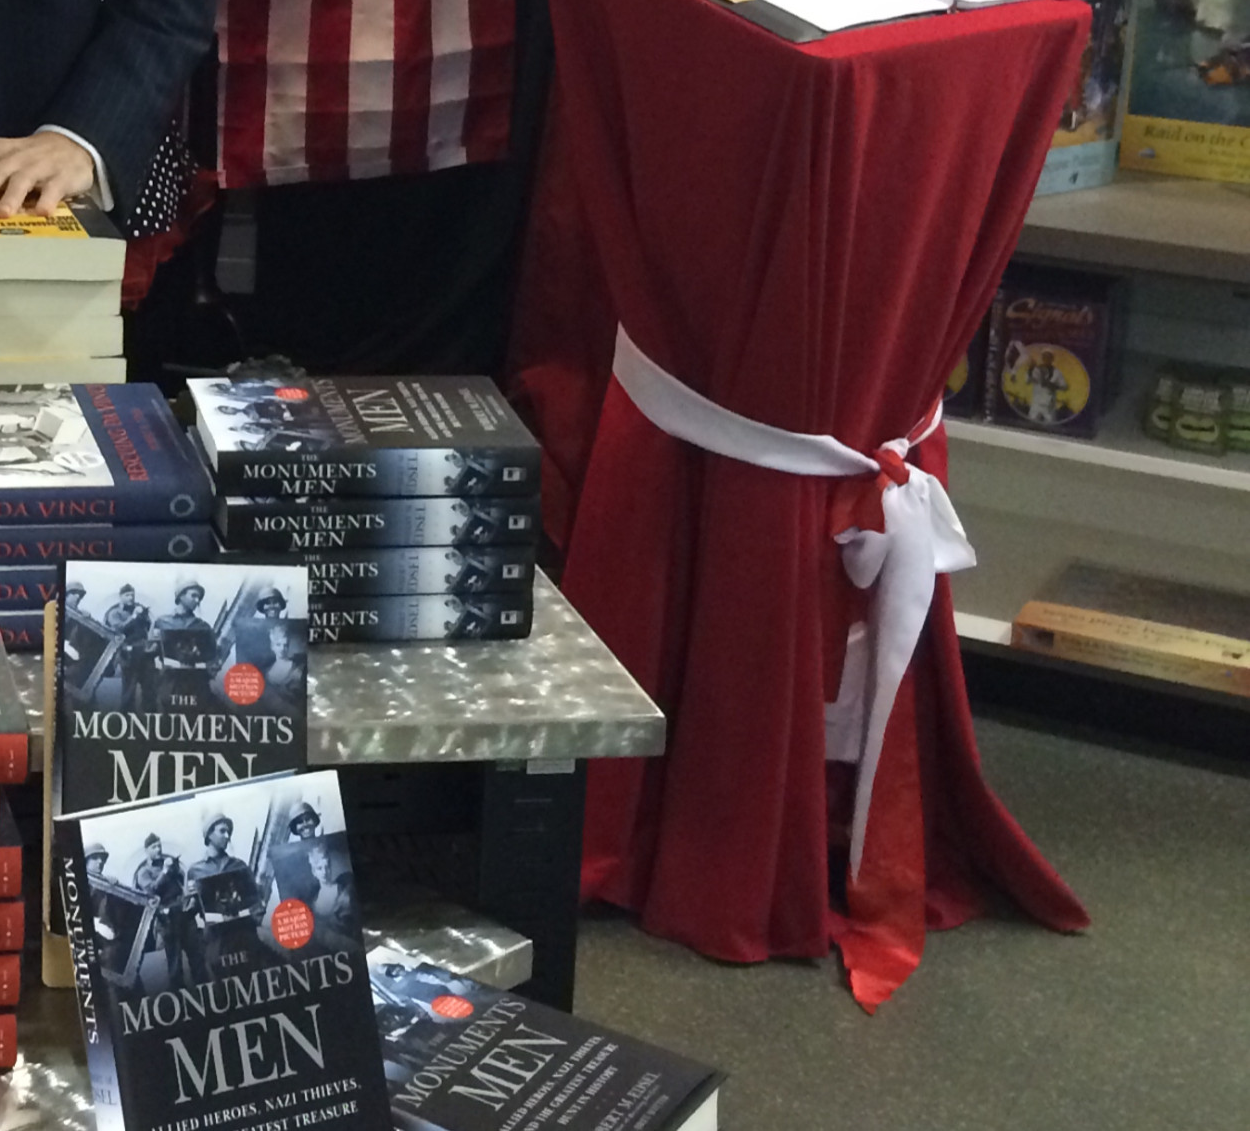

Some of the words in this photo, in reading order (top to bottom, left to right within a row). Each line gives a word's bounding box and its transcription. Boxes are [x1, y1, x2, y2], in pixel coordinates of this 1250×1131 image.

[1144, 126, 1182, 141] Raid
[1184, 133, 1205, 144] on
[1208, 131, 1235, 147] the
[243, 464, 377, 479] MONUMENTS
[281, 480, 336, 495] MEN
[38, 500, 116, 517] VINCI
[254, 514, 385, 532] MONUMENTS
[38, 541, 113, 557] VINCI
[291, 532, 345, 547] MEN
[309, 563, 379, 578] MENTS
[310, 611, 379, 626] MENTS
[170, 694, 197, 706] THE
[73, 710, 294, 744] MONUMENTS
[64, 858, 99, 1044] MONUMENTS
[220, 950, 248, 967] THE
[119, 951, 353, 1036] MONUMENTS
[165, 1004, 325, 1105] MEN
[395, 998, 526, 1108] MONUMENTS
[448, 1022, 568, 1111] MEN
[204, 1104, 262, 1125] HEROES,
[265, 1094, 298, 1111] NAZI
[302, 1077, 362, 1101] THIEVES,
[557, 1106, 580, 1125] HUNT
[588, 1065, 618, 1096] HISTORY
[295, 1101, 358, 1128] TREASURE
